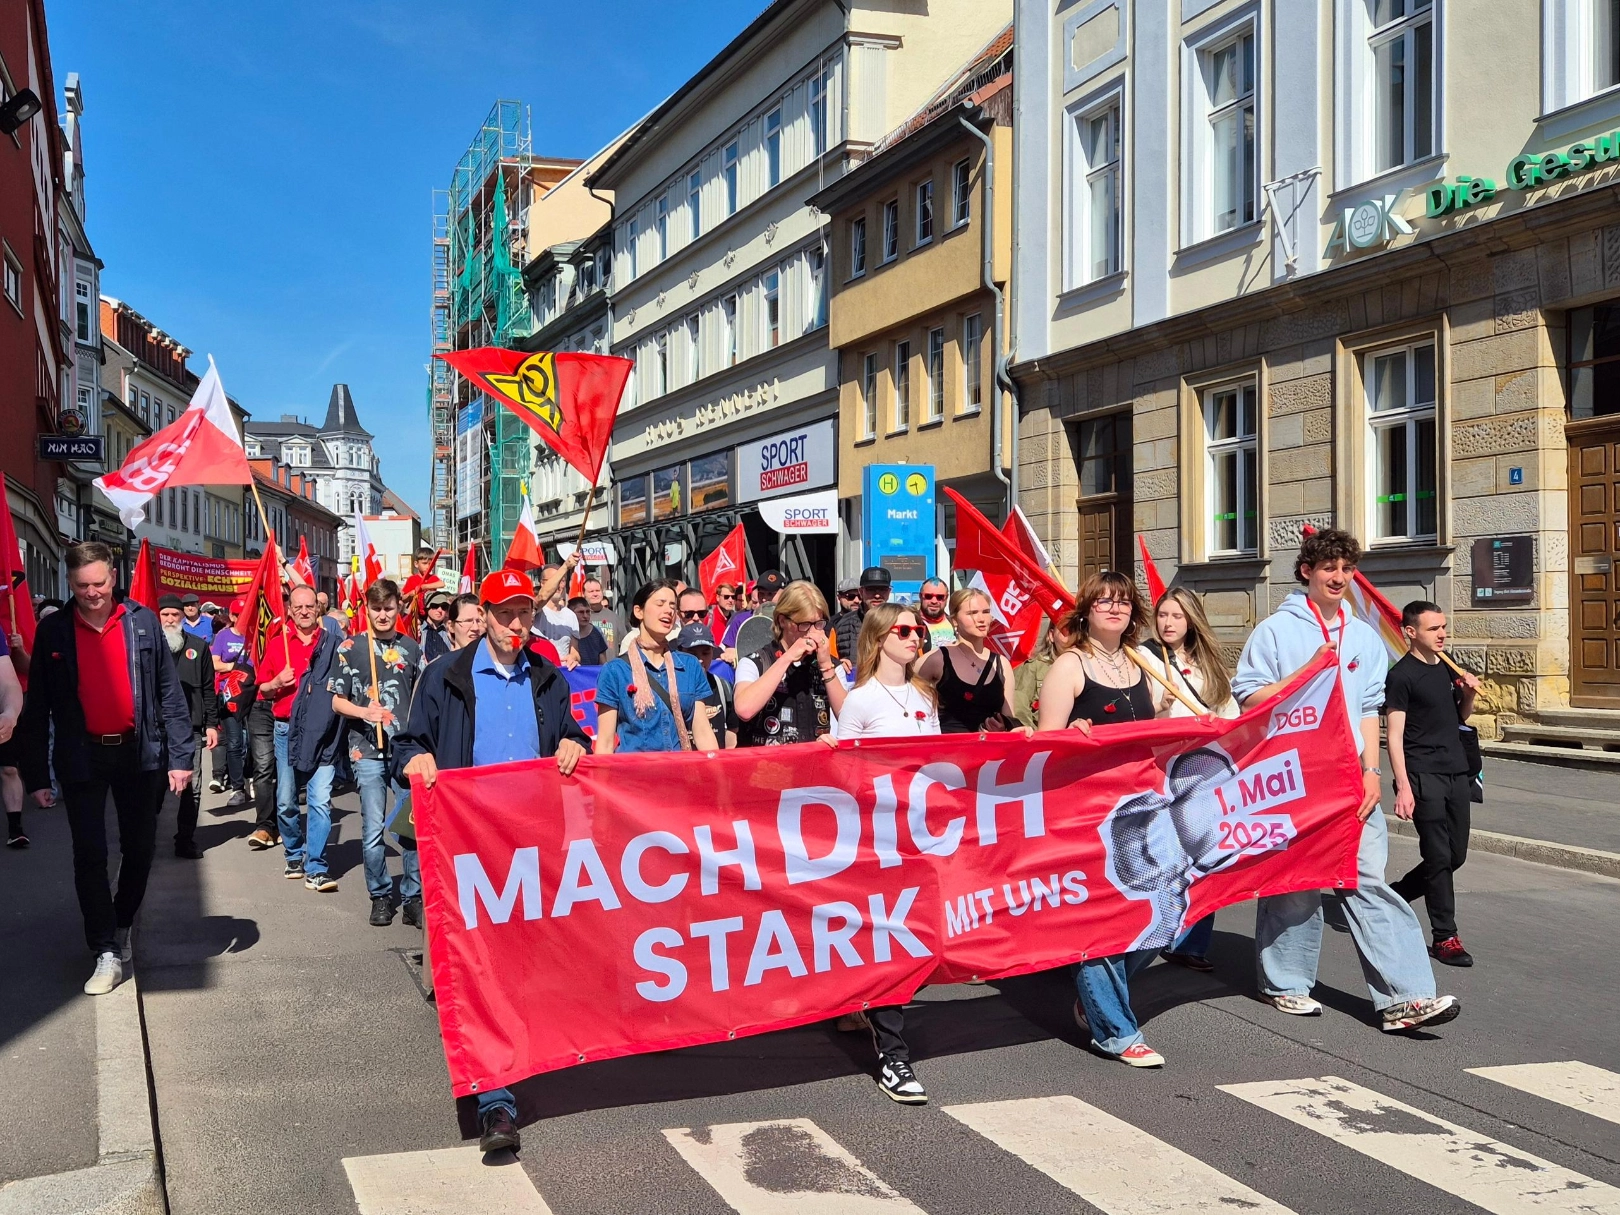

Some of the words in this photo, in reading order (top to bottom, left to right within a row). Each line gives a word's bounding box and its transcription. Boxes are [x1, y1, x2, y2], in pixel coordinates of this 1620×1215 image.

[1322, 187, 1414, 259] AOK
[1426, 175, 1496, 219] Die
[761, 434, 808, 472] SPORT
[760, 463, 807, 490] SCHWAGER
[1513, 471, 1519, 481] 4
[784, 508, 829, 520] SPORT
[784, 519, 829, 528] SCHWAGER
[887, 509, 918, 519] Markt
[159, 553, 171, 561] DER
[172, 557, 225, 569] KAPITALISMUS
[159, 560, 190, 572] BEDROHT
[191, 566, 203, 574] DIE
[160, 575, 238, 593] SOZIALISMUS!
[1274, 705, 1318, 731] DGB
[1237, 759, 1297, 808] Mai
[454, 819, 762, 930] MACH
[776, 750, 1052, 885] DICH
[1217, 821, 1289, 850] 2025
[632, 887, 933, 1002] STARK
[945, 887, 994, 938] MIT
[1002, 870, 1089, 916] UNS
